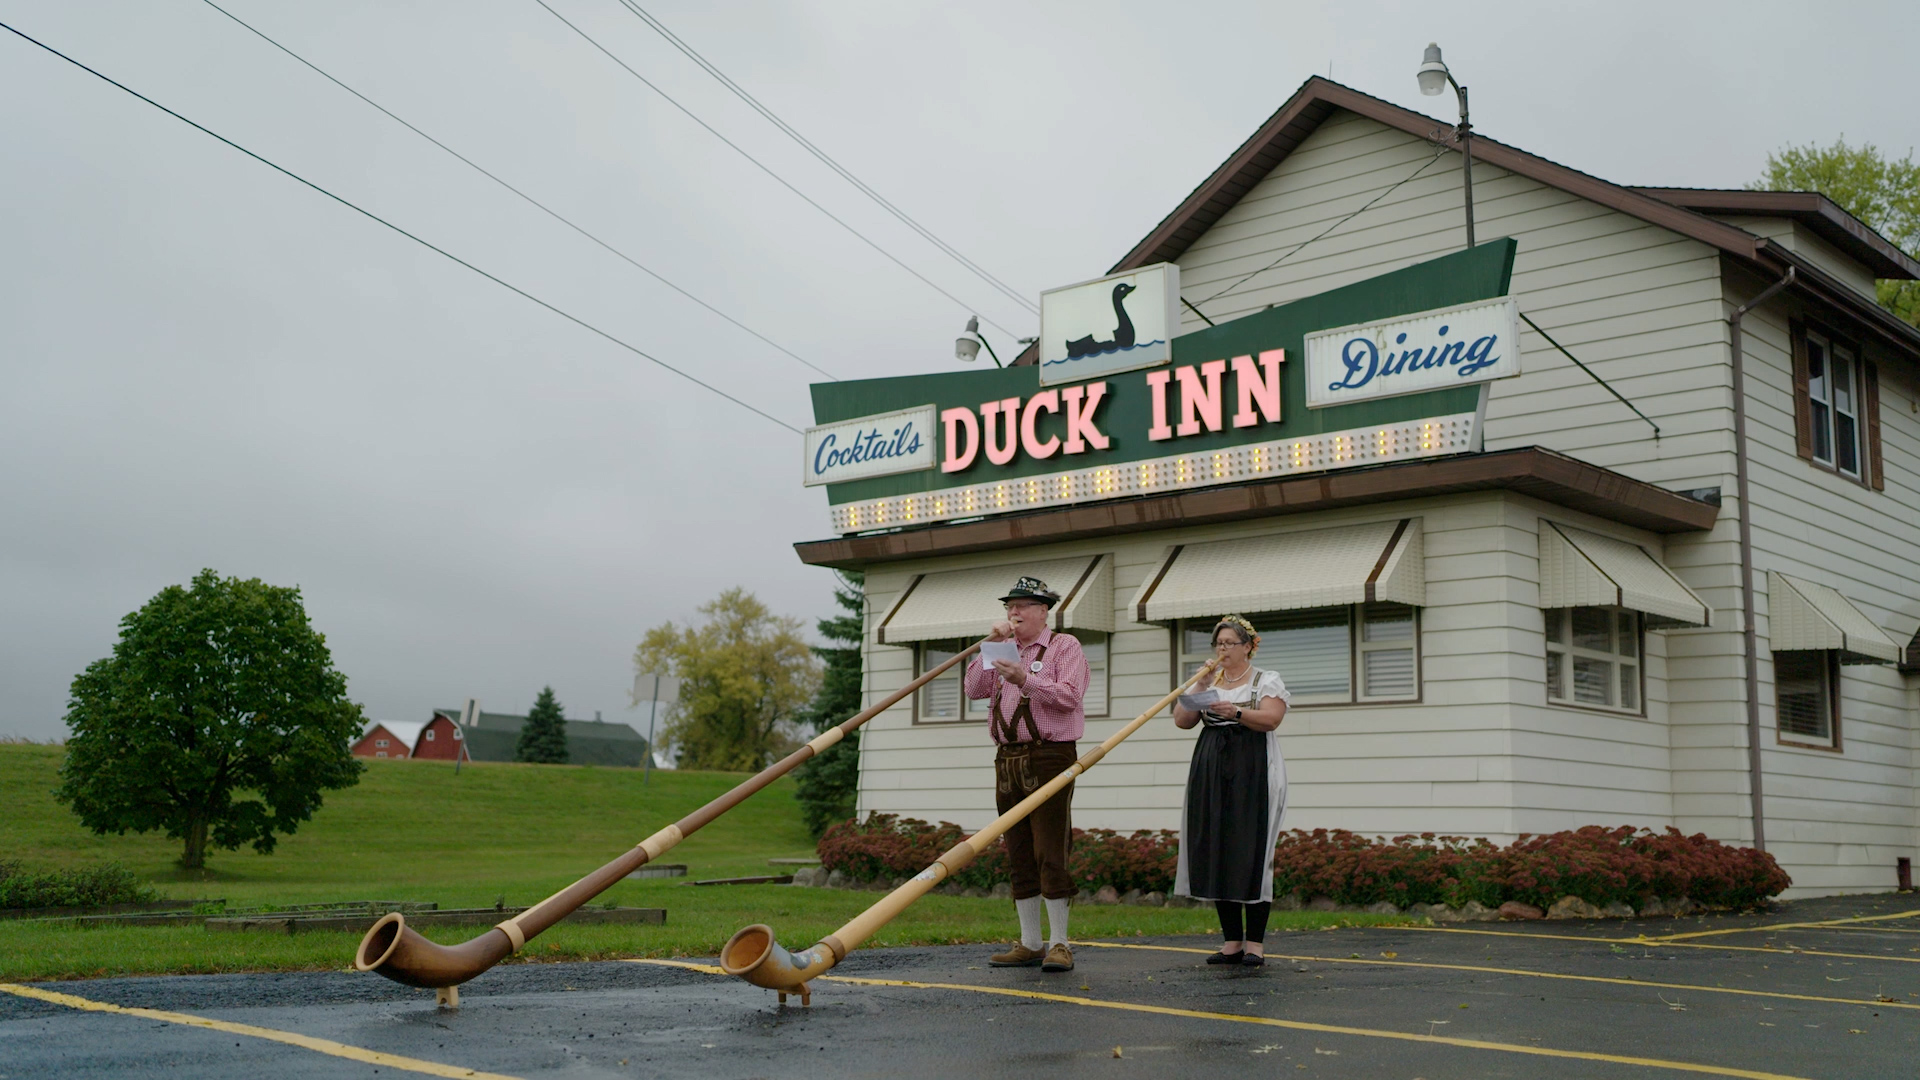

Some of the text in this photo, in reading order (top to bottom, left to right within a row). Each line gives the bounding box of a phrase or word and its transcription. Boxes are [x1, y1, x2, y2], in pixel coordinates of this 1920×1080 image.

[1329, 325, 1501, 391] Dining
[940, 348, 1286, 474] DUCK INN
[815, 422, 924, 475] Cocktails
